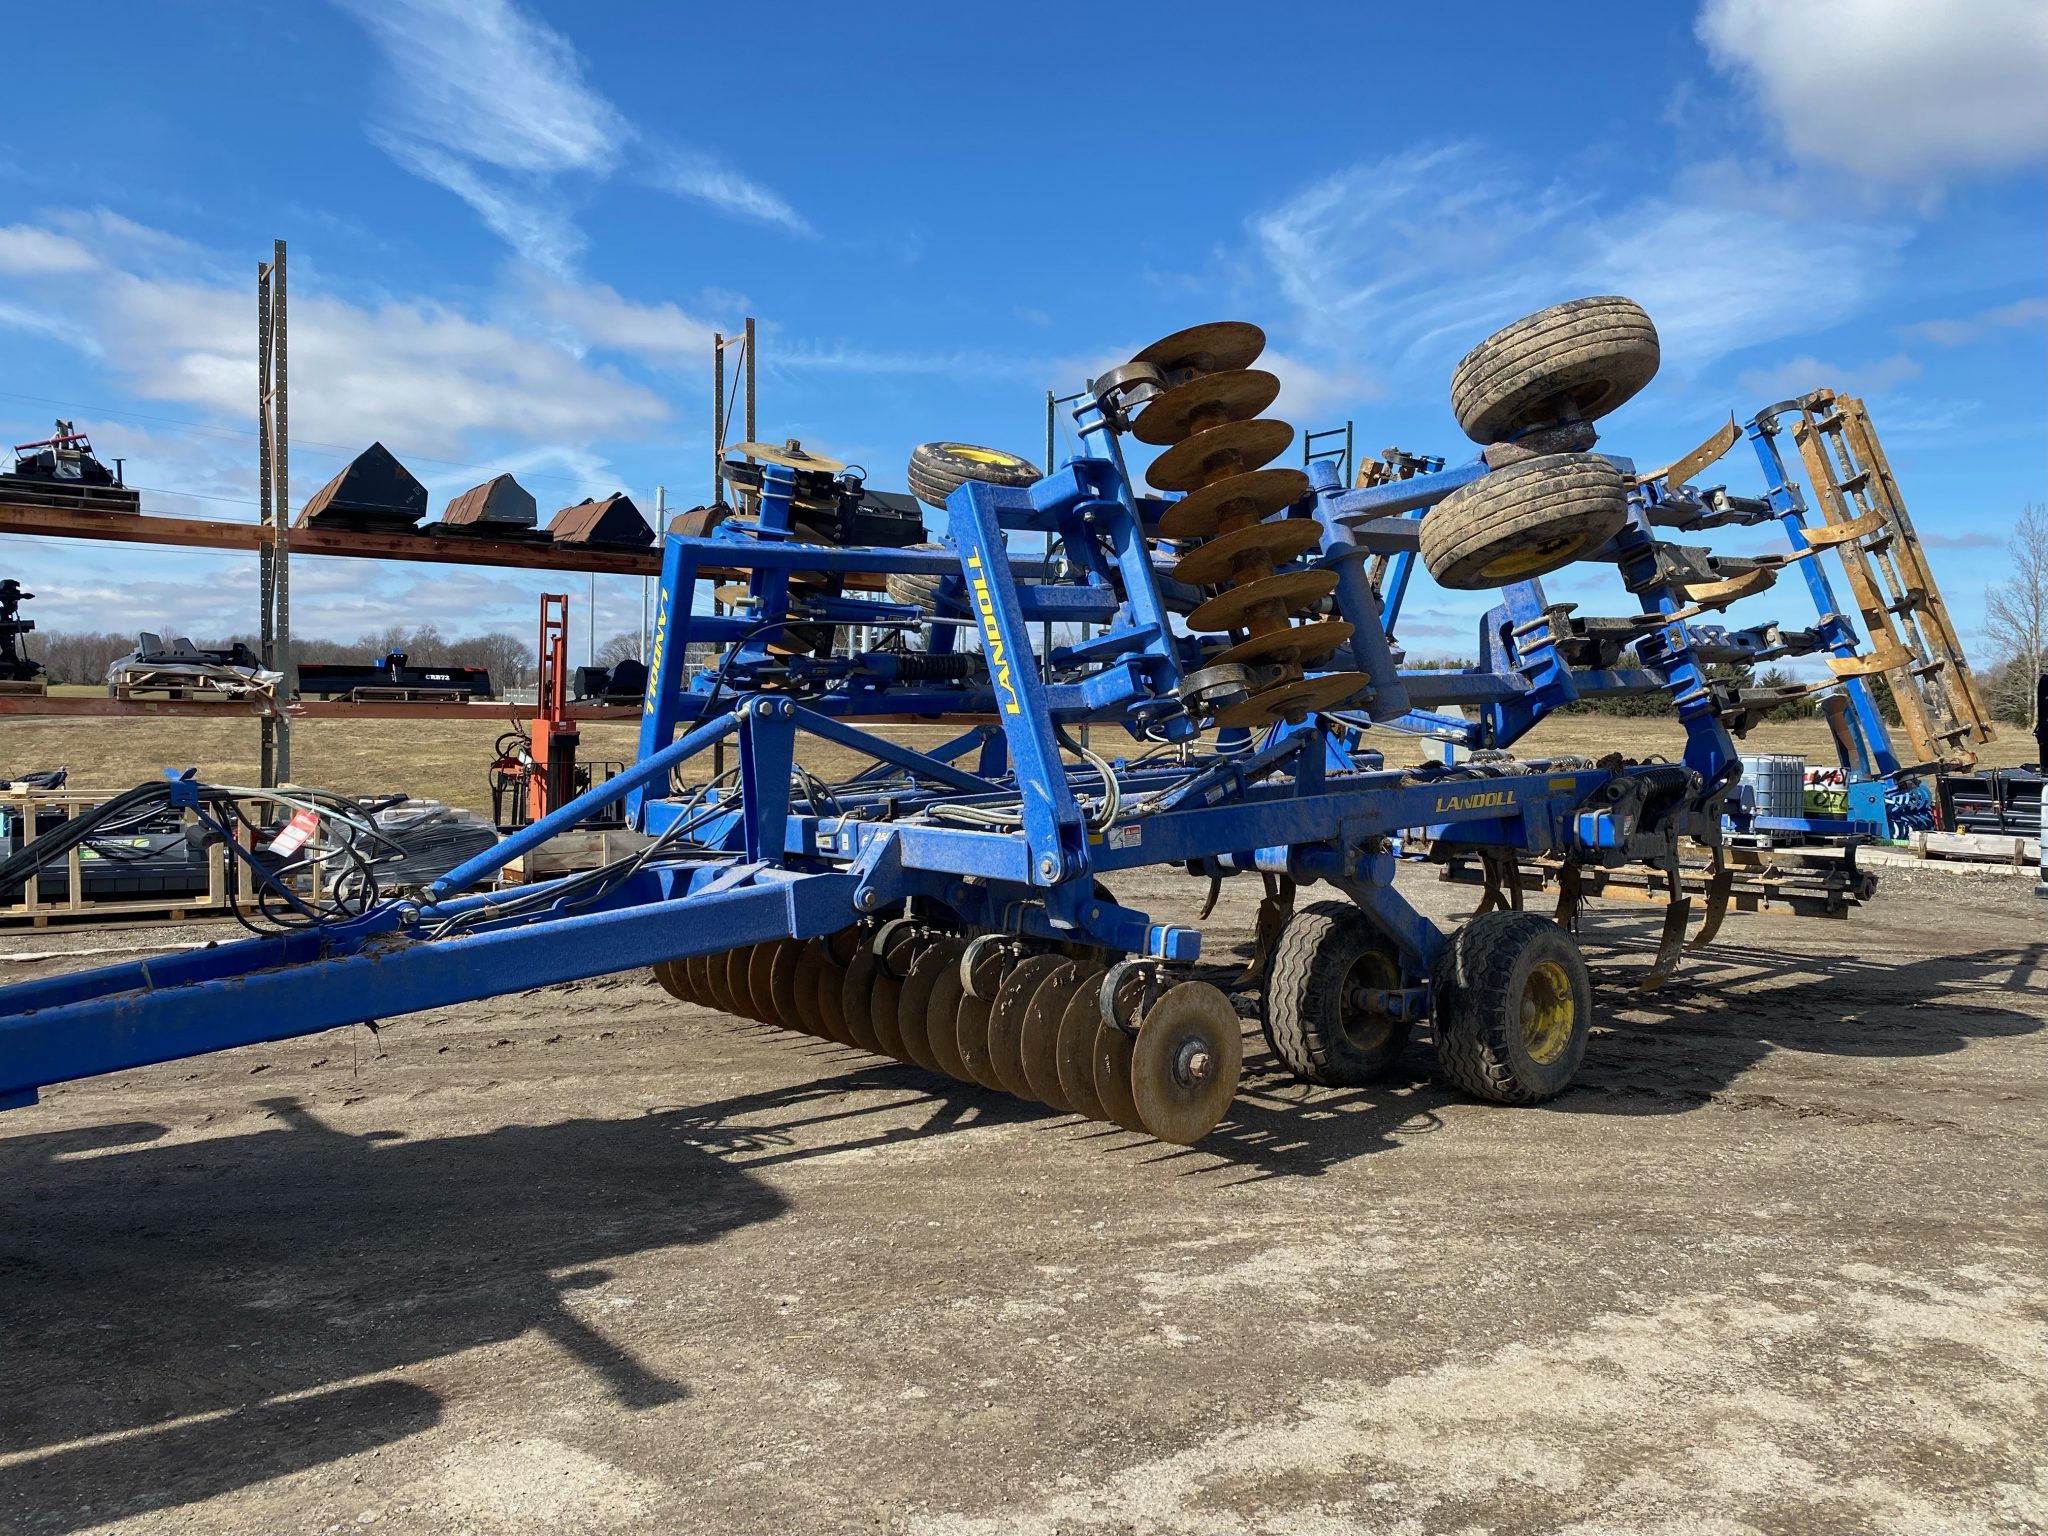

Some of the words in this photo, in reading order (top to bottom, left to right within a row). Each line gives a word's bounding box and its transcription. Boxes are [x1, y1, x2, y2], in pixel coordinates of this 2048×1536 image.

[646, 587, 668, 715] LANDOLL
[967, 544, 1021, 715] LANDOLL
[1435, 790, 1517, 813] LANDOLL
